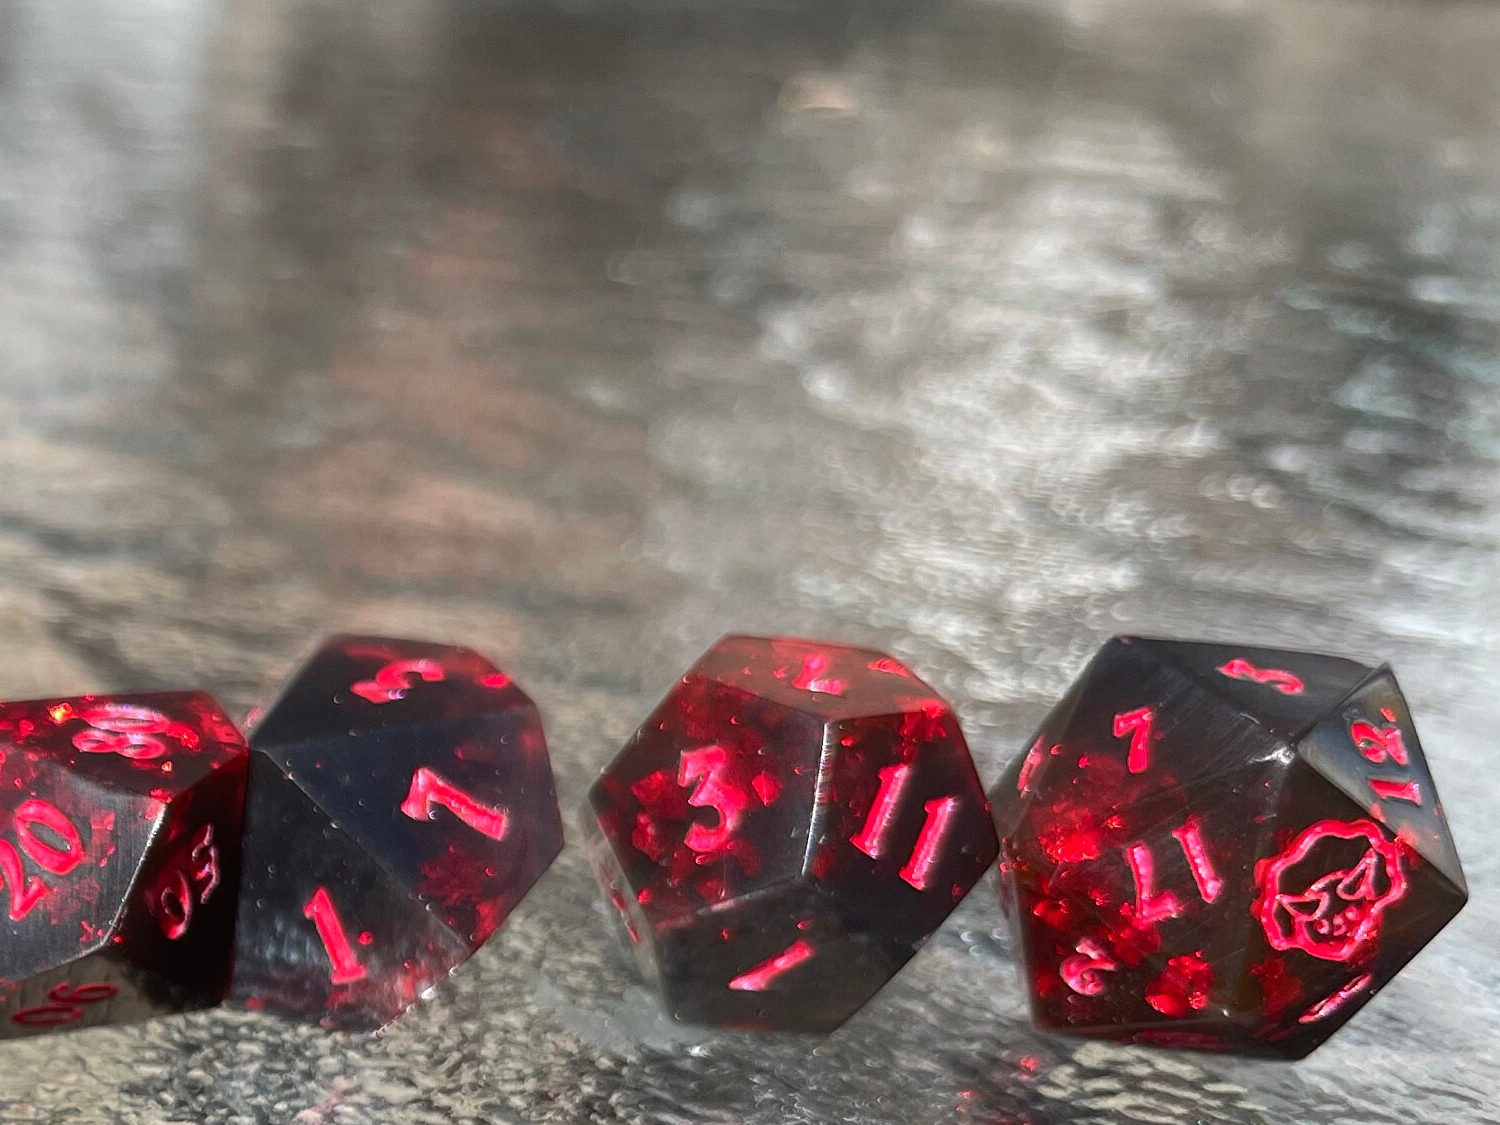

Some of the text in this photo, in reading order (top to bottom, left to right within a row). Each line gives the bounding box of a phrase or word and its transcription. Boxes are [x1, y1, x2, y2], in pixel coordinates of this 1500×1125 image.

[1113, 706, 1155, 774] 7
[399, 766, 510, 841] 7
[677, 744, 749, 853] 3
[849, 763, 958, 893] 11
[302, 885, 368, 985] 1
